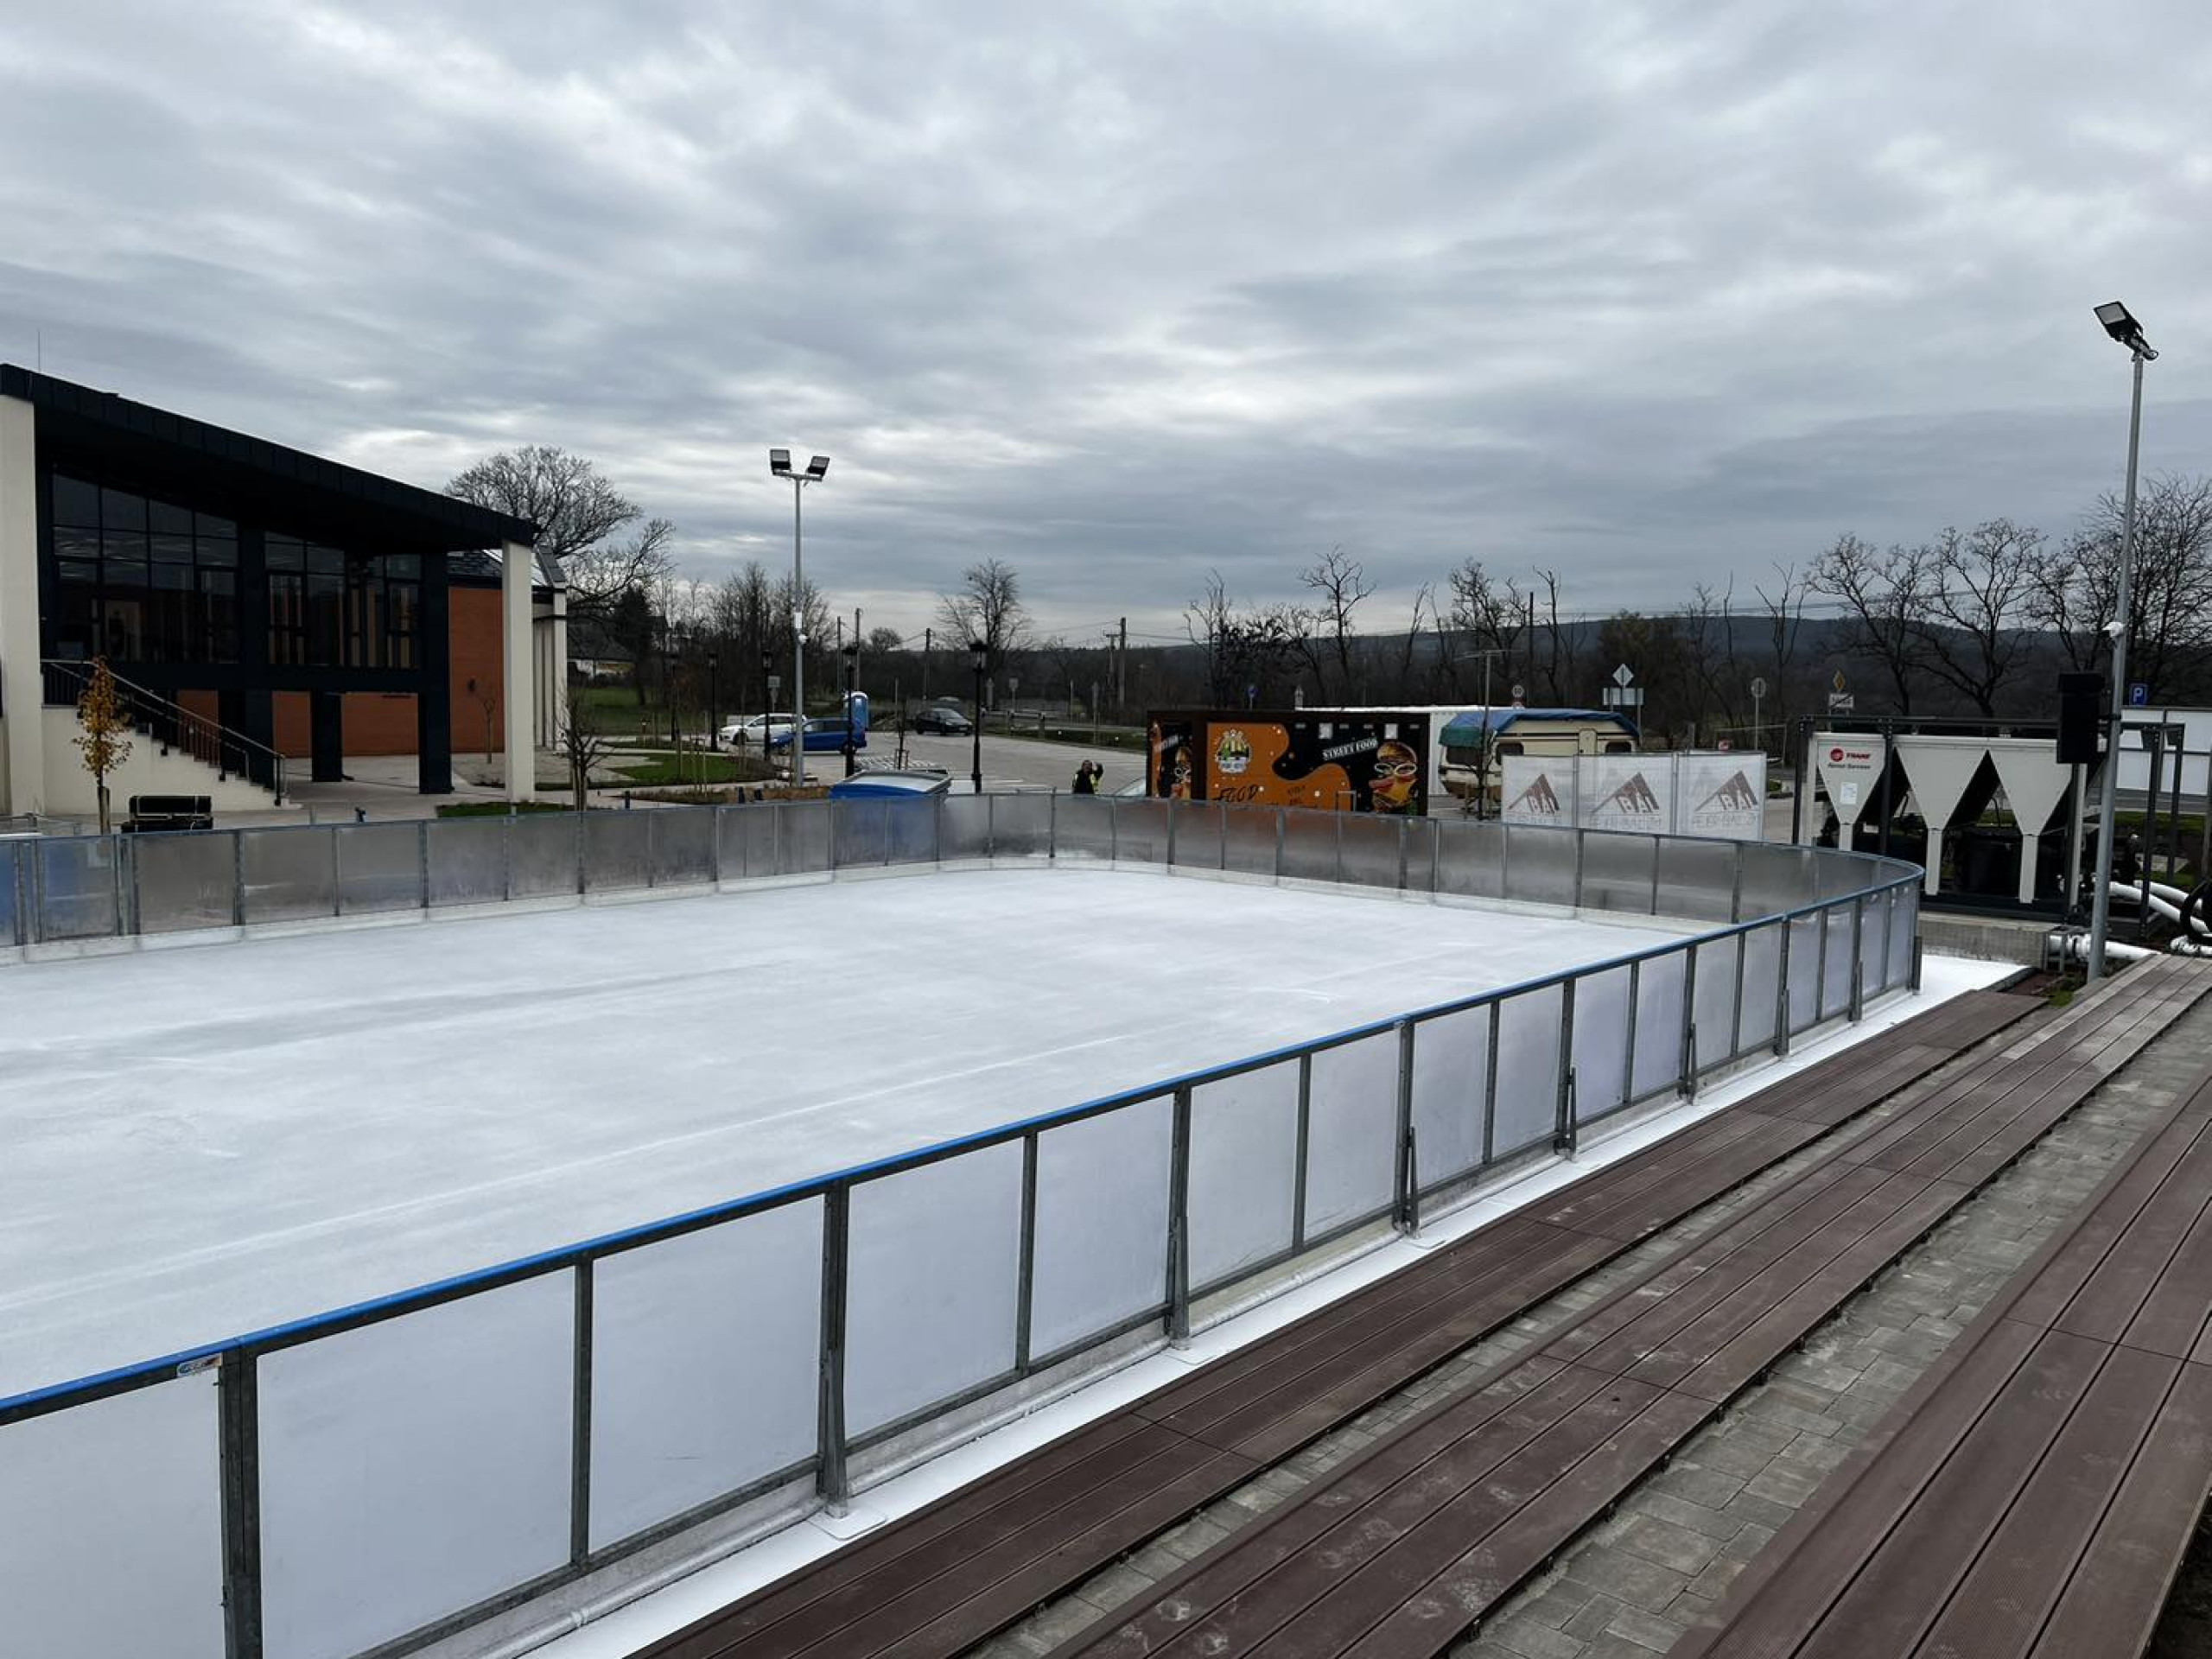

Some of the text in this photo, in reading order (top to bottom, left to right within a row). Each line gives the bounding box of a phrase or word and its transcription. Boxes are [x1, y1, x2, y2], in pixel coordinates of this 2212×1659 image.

[2133, 688, 2144, 702] P
[1322, 738, 1378, 760] STREET FOOD
